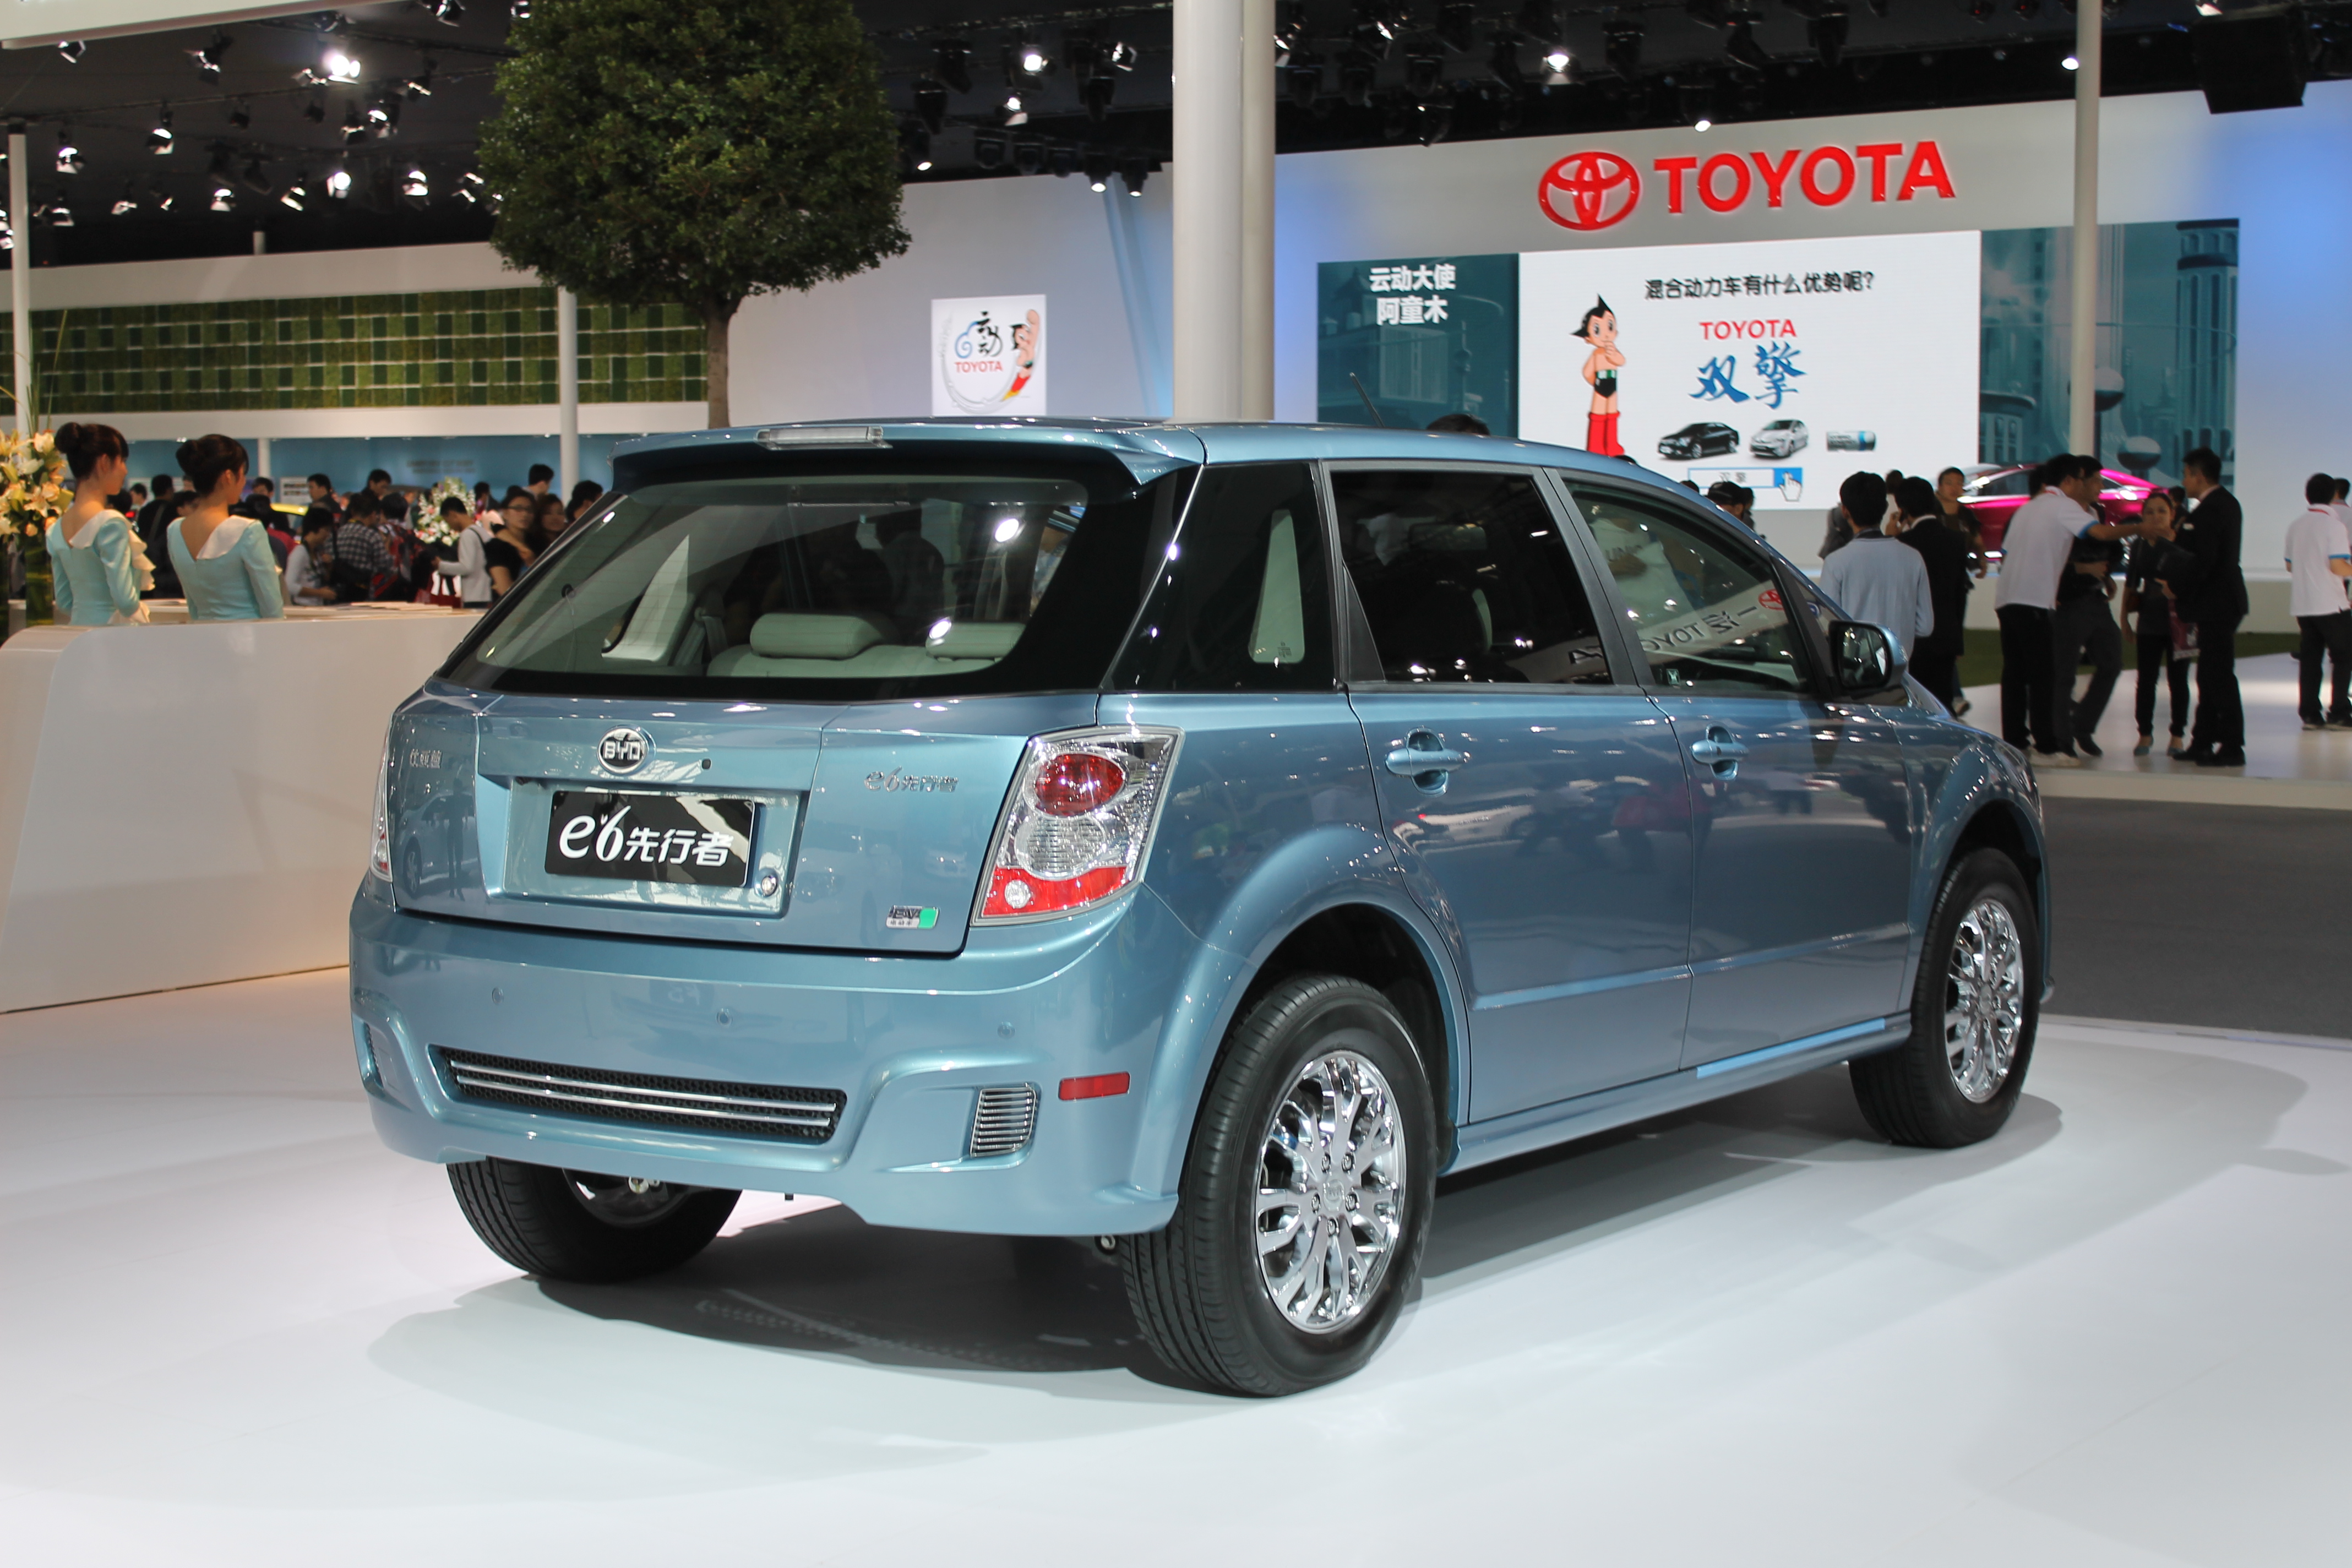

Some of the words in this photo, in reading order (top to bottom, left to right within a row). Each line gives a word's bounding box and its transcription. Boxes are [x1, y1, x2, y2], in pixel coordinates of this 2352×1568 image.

[1653, 140, 1957, 214] TOYOTA
[1369, 263, 1456, 292] 云动大使
[1376, 294, 1449, 326] 阿童木
[1699, 319, 1797, 340] TOYOTA
[954, 361, 1003, 373] TOYOTA
[1688, 341, 1807, 410] 双擎
[603, 741, 641, 760] BYD
